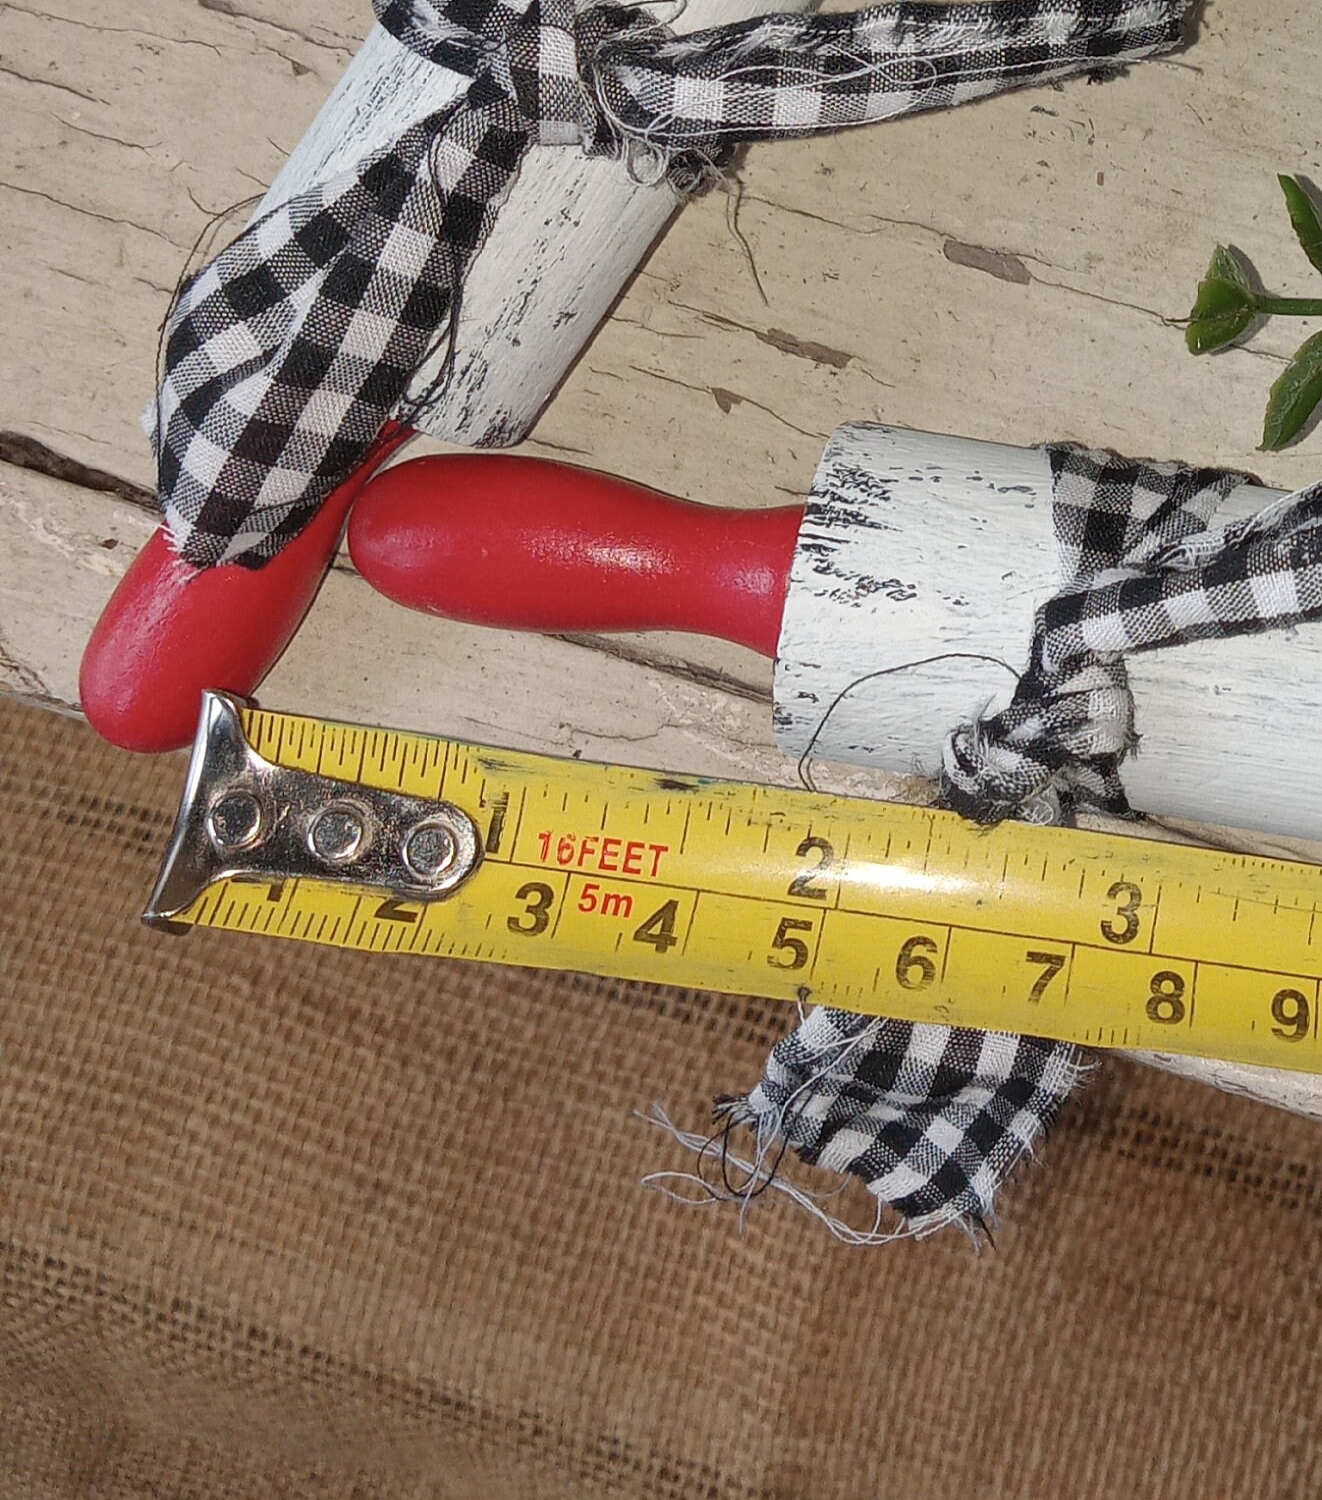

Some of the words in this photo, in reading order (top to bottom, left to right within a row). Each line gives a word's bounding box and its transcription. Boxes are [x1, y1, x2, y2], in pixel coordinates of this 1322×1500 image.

[538, 831, 669, 877] 16FEET
[786, 835, 834, 901] 2
[1099, 881, 1143, 946] 3
[577, 883, 634, 918] 5m
[506, 881, 555, 937] 3
[632, 899, 680, 955] 4
[766, 916, 813, 971] 5
[895, 935, 938, 992] 6
[1024, 950, 1067, 1005] 7
[1145, 969, 1187, 1026] 8
[1270, 987, 1312, 1043] 9
